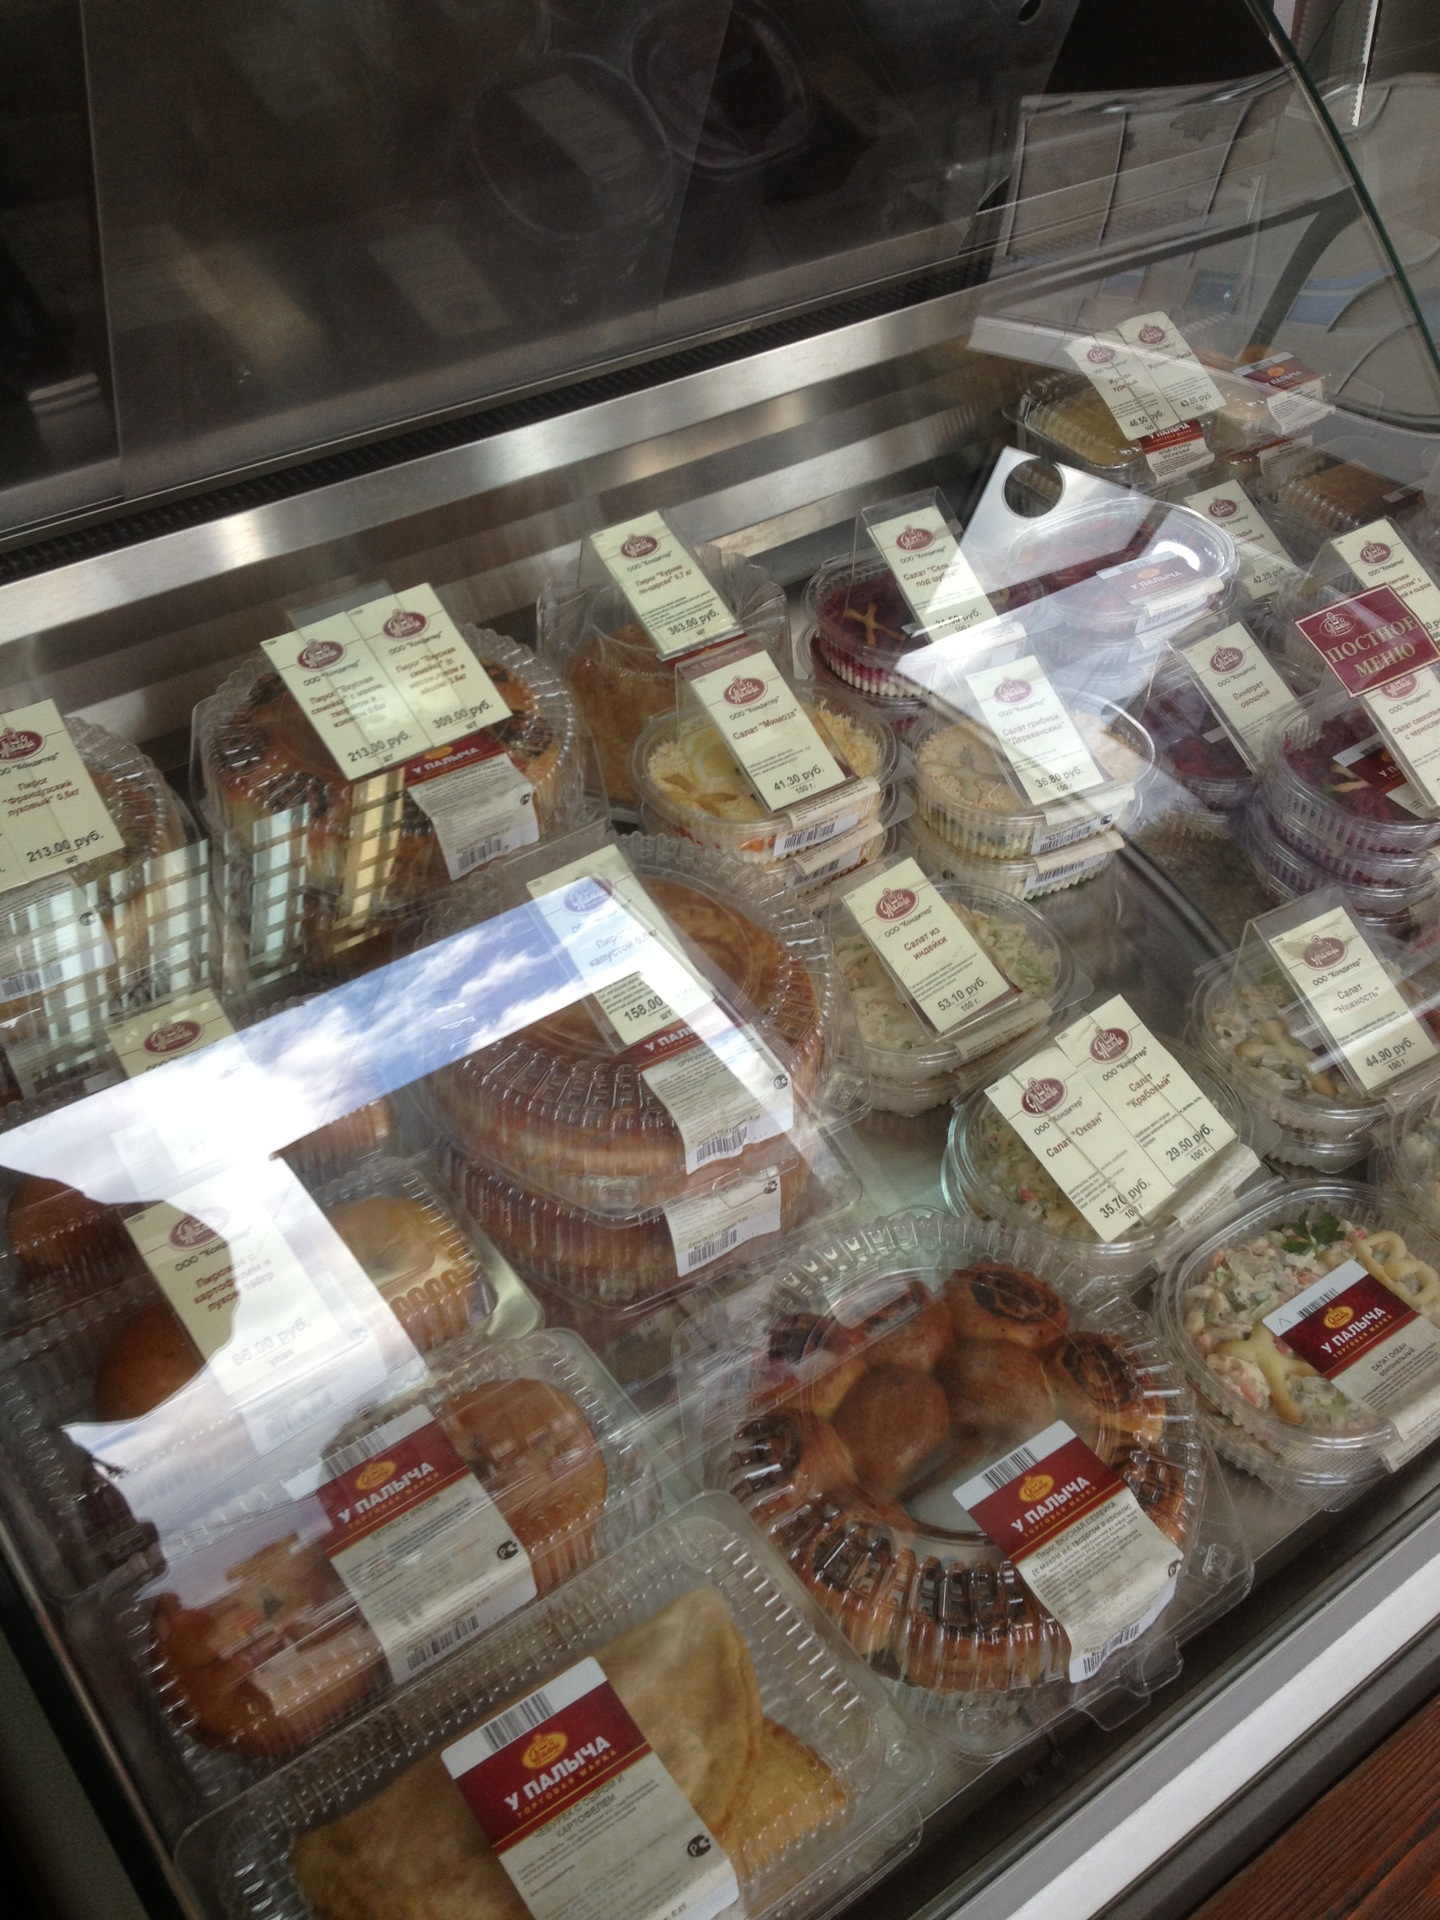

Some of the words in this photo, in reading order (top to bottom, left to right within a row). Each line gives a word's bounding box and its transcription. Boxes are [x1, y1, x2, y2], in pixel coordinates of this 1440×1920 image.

[627, 563, 642, 573] ООО
[900, 555, 915, 565] ООО
[903, 569, 927, 582] Салат
[915, 579, 932, 589] под
[1368, 568, 1381, 578] ООО
[668, 618, 698, 636] 363.00
[699, 609, 720, 625] руб.
[389, 645, 406, 655] ООО
[1325, 616, 1418, 664] ПОСТНОЕ
[1354, 642, 1416, 679] МЕНЮ
[303, 675, 322, 687] ООО
[1217, 677, 1231, 688] ООО
[1232, 681, 1264, 701] Винегрет
[469, 699, 494, 717] руб.
[1240, 689, 1271, 709] овощной
[1388, 705, 1403, 715] ООО
[729, 710, 746, 721] ООО
[733, 726, 759, 741] Салат
[758, 708, 804, 730] "Мимоза"
[998, 708, 1013, 719] ООО
[1002, 724, 1026, 737] Салат
[1027, 712, 1060, 730] грибной
[1007, 721, 1065, 746] "Деревенский"
[1392, 721, 1413, 735] Салат
[347, 740, 386, 763] 213.00
[387, 730, 413, 750] руб.
[412, 766, 422, 775] У
[423, 747, 480, 771] ПАЛЫЧА
[18, 777, 48, 791] Пирог
[774, 773, 801, 792] 41.30
[802, 764, 825, 782] руб.
[1035, 772, 1062, 789] 36.80
[1063, 765, 1085, 781] руб.
[795, 785, 809, 795] 100
[26, 839, 71, 863] 213.00
[74, 829, 105, 849] руб.
[884, 924, 900, 938] ООО
[899, 905, 934, 929] "Кондитер"
[904, 933, 929, 952] Салат
[930, 926, 941, 938] из
[913, 936, 949, 961] индейки
[589, 941, 635, 968] капустой
[1312, 975, 1329, 987] ООО
[1327, 958, 1362, 979] "Кондитер"
[937, 989, 966, 1012] 53.10
[966, 976, 988, 998] руб.
[1333, 987, 1380, 1015] "Нежность"
[1337, 983, 1363, 1001] Салат
[624, 995, 664, 1023] 158.00
[660, 1008, 674, 1021] шт
[960, 1000, 975, 1013] 100
[645, 1040, 655, 1052] У
[1366, 1047, 1393, 1069] 44.90
[1393, 1037, 1416, 1057] руб.
[1102, 1067, 1118, 1082] ООО
[1116, 1046, 1148, 1072] "Кондитер"
[1388, 1061, 1402, 1073] 100
[1125, 1073, 1172, 1110] "Крабовый"
[1128, 1073, 1153, 1093] Салат
[1034, 1121, 1050, 1136] ООО
[1046, 1137, 1073, 1159] Салат
[1070, 1111, 1104, 1139] "Океан"
[1165, 1137, 1194, 1162] 29.50
[1192, 1123, 1215, 1145] руб.
[1190, 1151, 1205, 1163] 100
[1099, 1194, 1130, 1219] 35.70
[1127, 1177, 1152, 1201] руб.
[174, 1256, 199, 1272] ООО
[1320, 1343, 1333, 1355] У
[1332, 1306, 1387, 1348] ПАЛЫЧА
[1332, 1331, 1369, 1359] ТОРГОВАЯ
[1369, 1313, 1394, 1334] МАРКА
[1371, 1355, 1391, 1373] САЛАТ
[337, 1509, 352, 1524] У
[354, 1461, 435, 1515] ПАЛЫЧА
[1010, 1518, 1025, 1533] У
[1024, 1475, 1091, 1525] ПАЛЫЧА
[1023, 1505, 1070, 1538] ТОРГОВАЯ
[1070, 1484, 1098, 1507] МАРКА
[1035, 1543, 1057, 1560] Пирог
[1054, 1521, 1087, 1547] ВКУСНАЯ
[1084, 1499, 1117, 1526] СЕМЕЙКА
[504, 1793, 522, 1812] У
[522, 1735, 613, 1801] ПАЛЫЧА
[516, 1776, 576, 1820] ТОРГОВАЯ
[578, 1748, 618, 1778] МАРКА
[556, 1792, 618, 1838] КАРТОФЕЛЕМ
